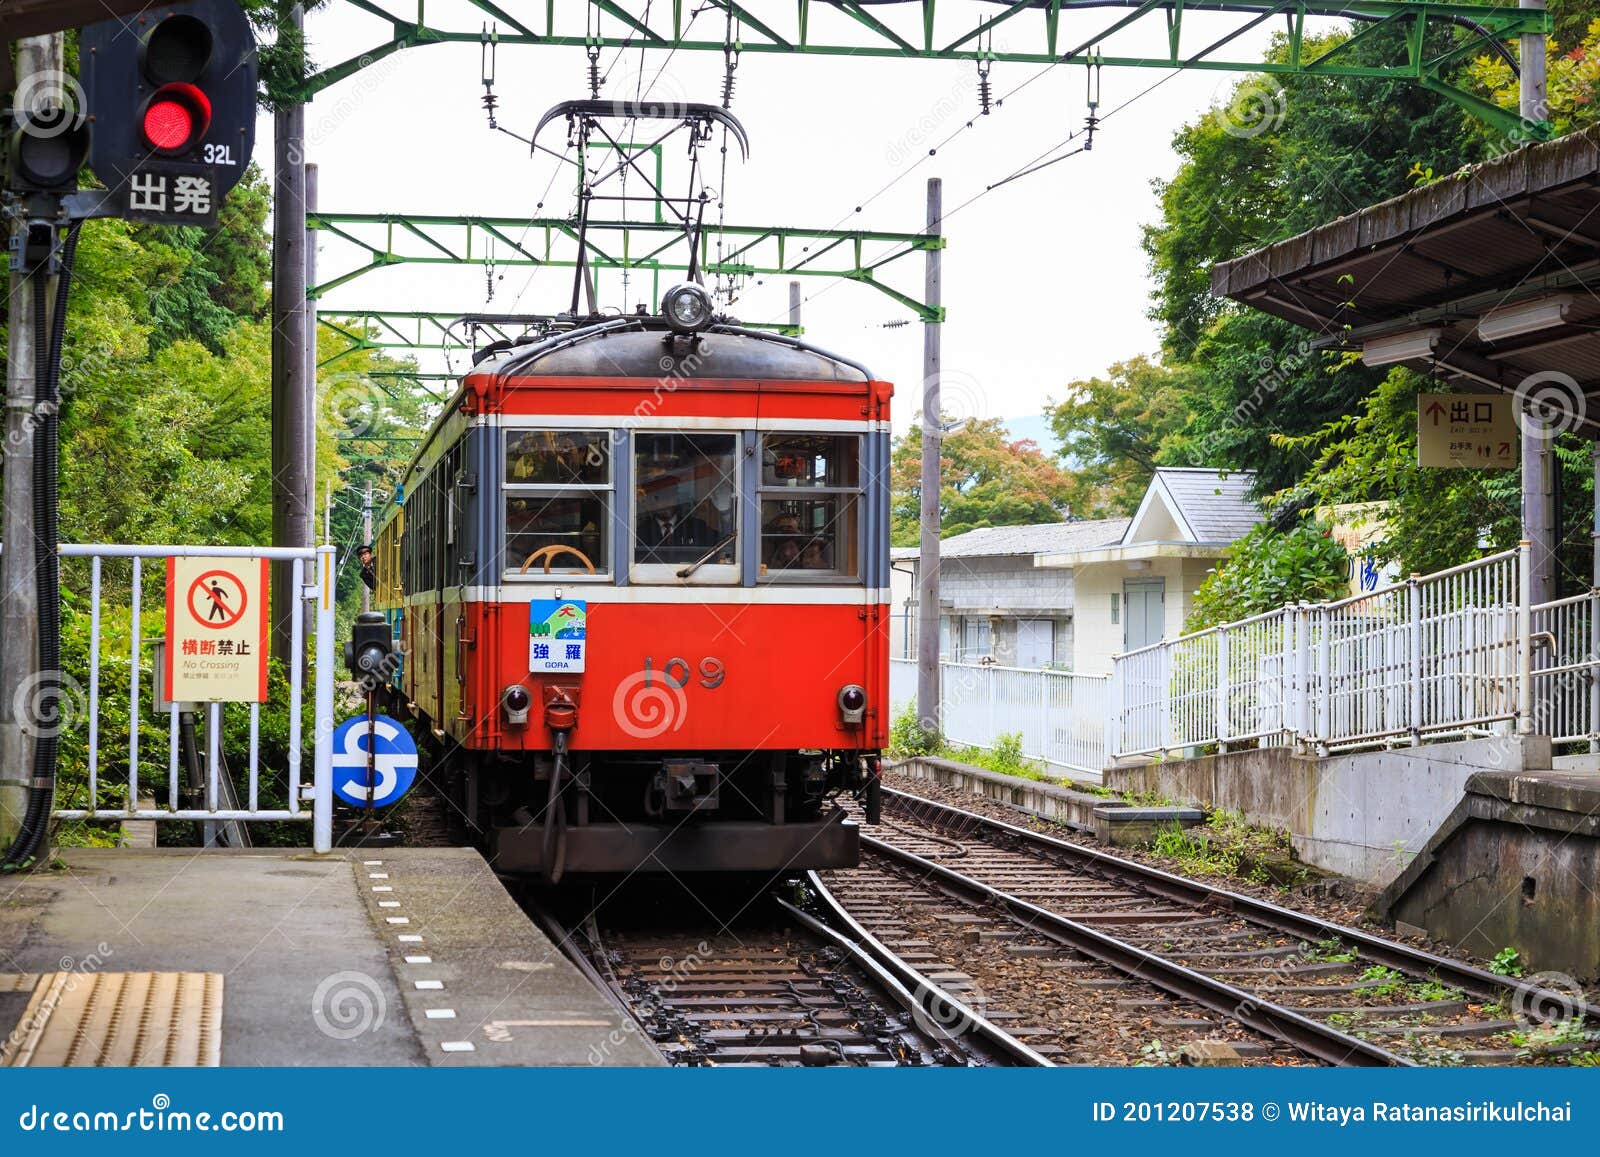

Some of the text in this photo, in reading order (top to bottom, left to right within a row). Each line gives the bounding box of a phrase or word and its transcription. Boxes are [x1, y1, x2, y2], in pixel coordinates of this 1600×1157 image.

[204, 143, 236, 165] 32L
[130, 173, 211, 214] 出発
[1450, 401, 1492, 423] 出口
[182, 639, 251, 656] 横断禁止
[183, 660, 240, 671] No Crossing
[545, 661, 569, 669] GORA
[645, 656, 725, 689] 109
